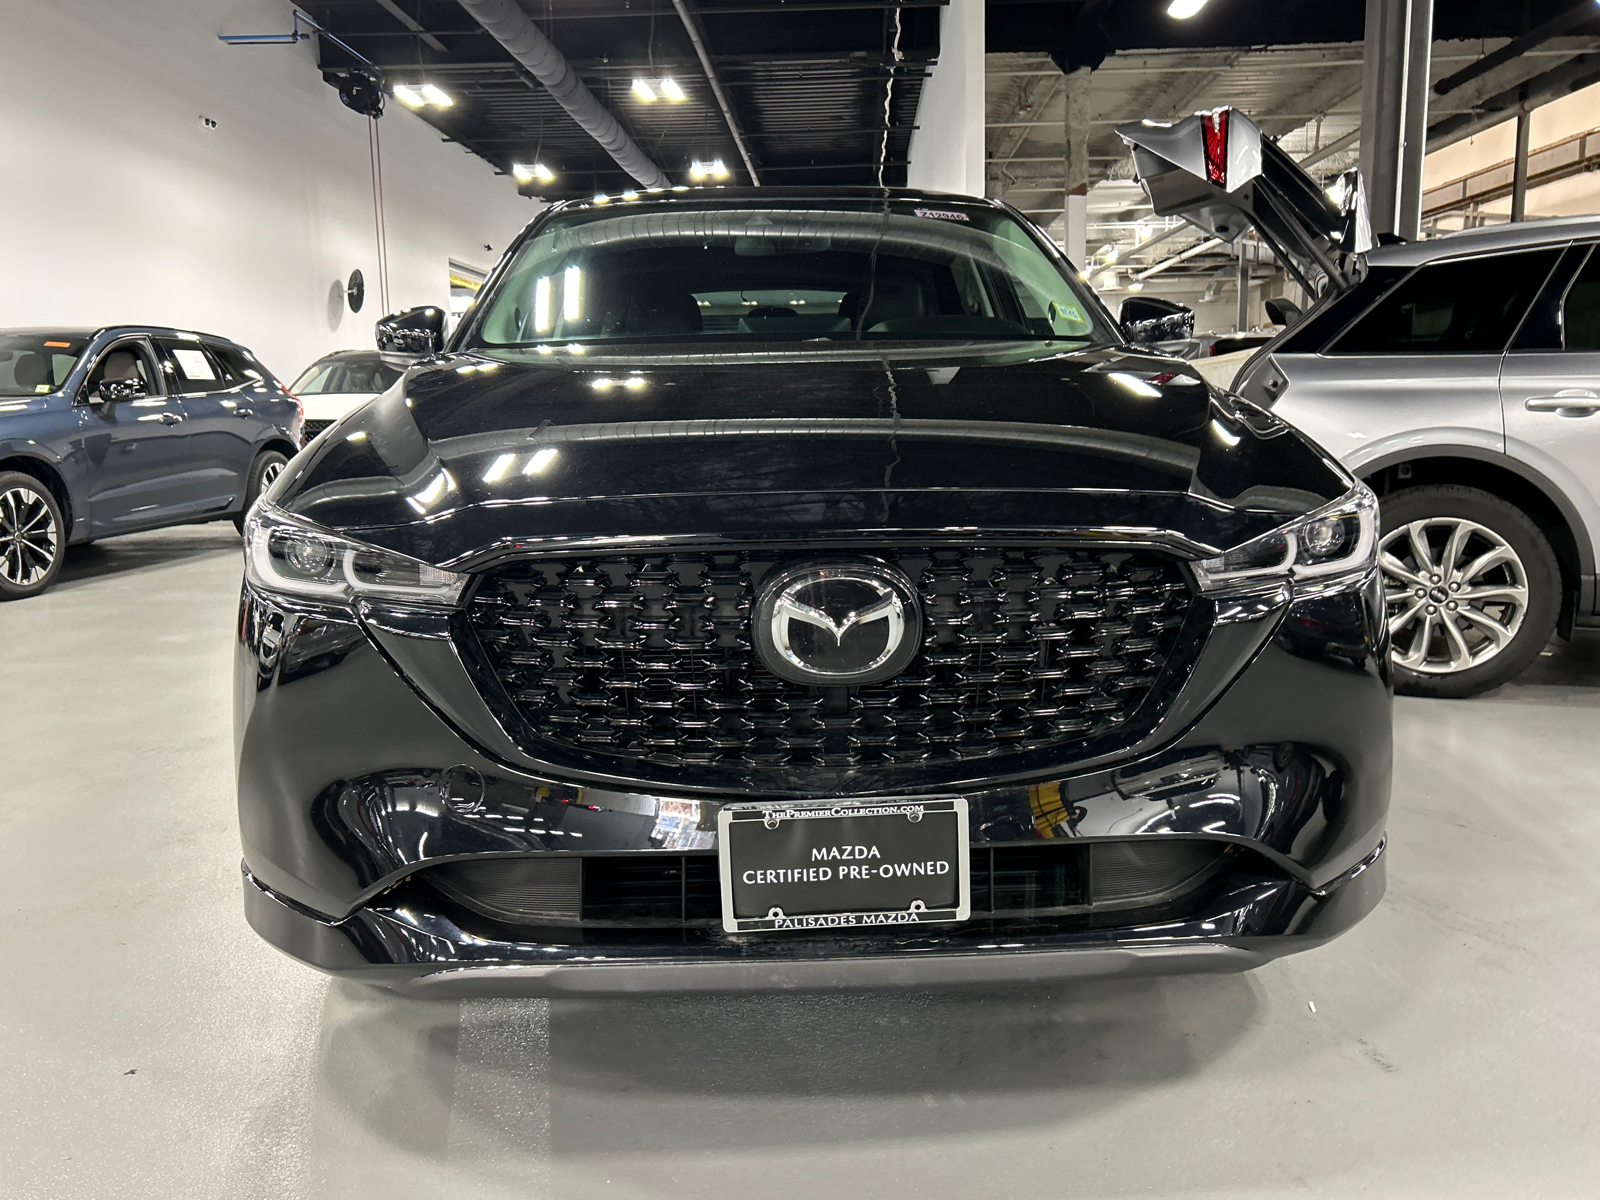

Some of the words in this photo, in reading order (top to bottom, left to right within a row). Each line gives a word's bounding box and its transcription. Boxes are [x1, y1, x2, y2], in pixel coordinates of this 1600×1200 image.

[811, 845, 881, 862] MAZDA
[742, 867, 832, 885] CERTIFIED
[838, 860, 950, 880] PRE-OWNED
[774, 916, 856, 929] PALISADES
[862, 912, 919, 925] MAZDA
